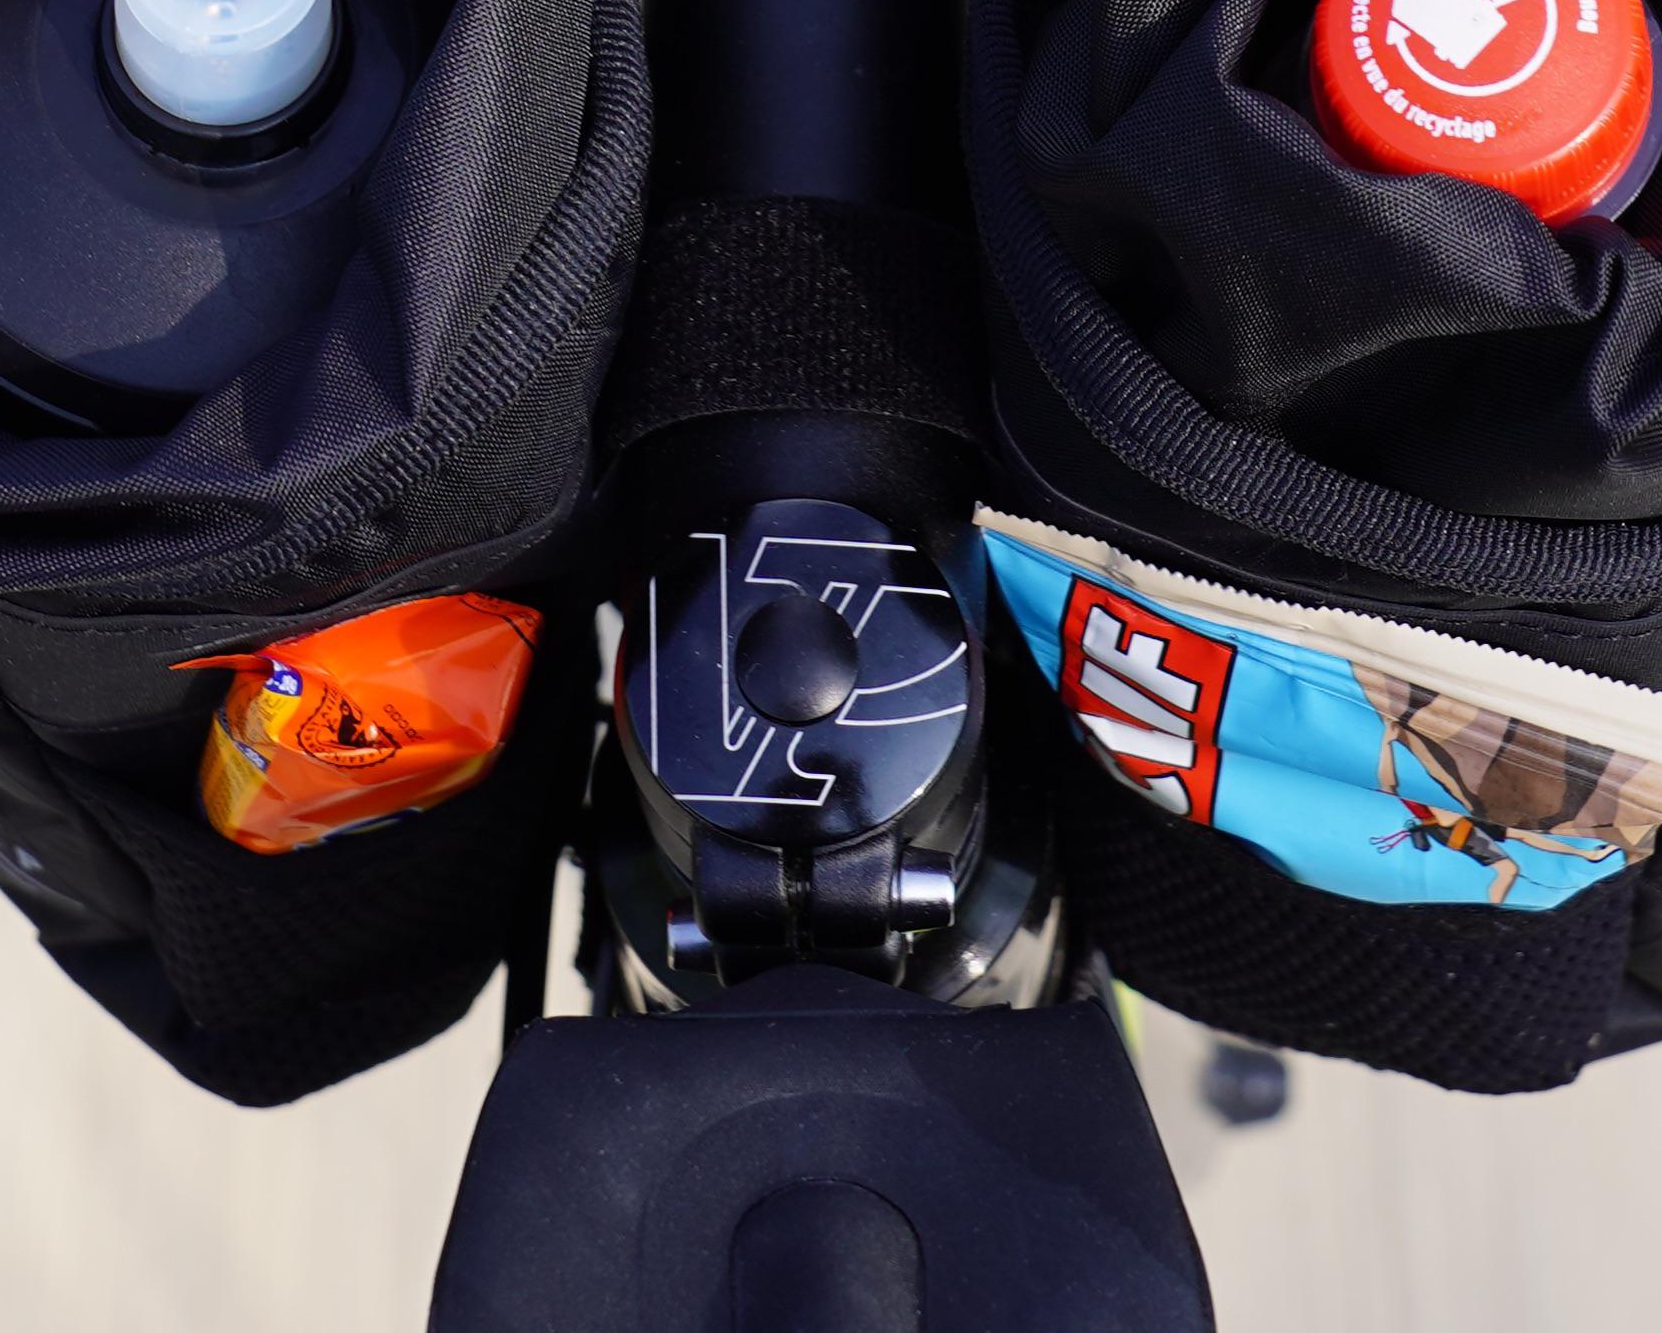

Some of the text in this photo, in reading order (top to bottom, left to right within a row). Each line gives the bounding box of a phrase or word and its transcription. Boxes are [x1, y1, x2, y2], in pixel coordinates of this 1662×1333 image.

[1352, 35, 1374, 61] en
[1360, 57, 1390, 94] vue
[1382, 88, 1410, 114] du
[1405, 104, 1498, 144] recyclage
